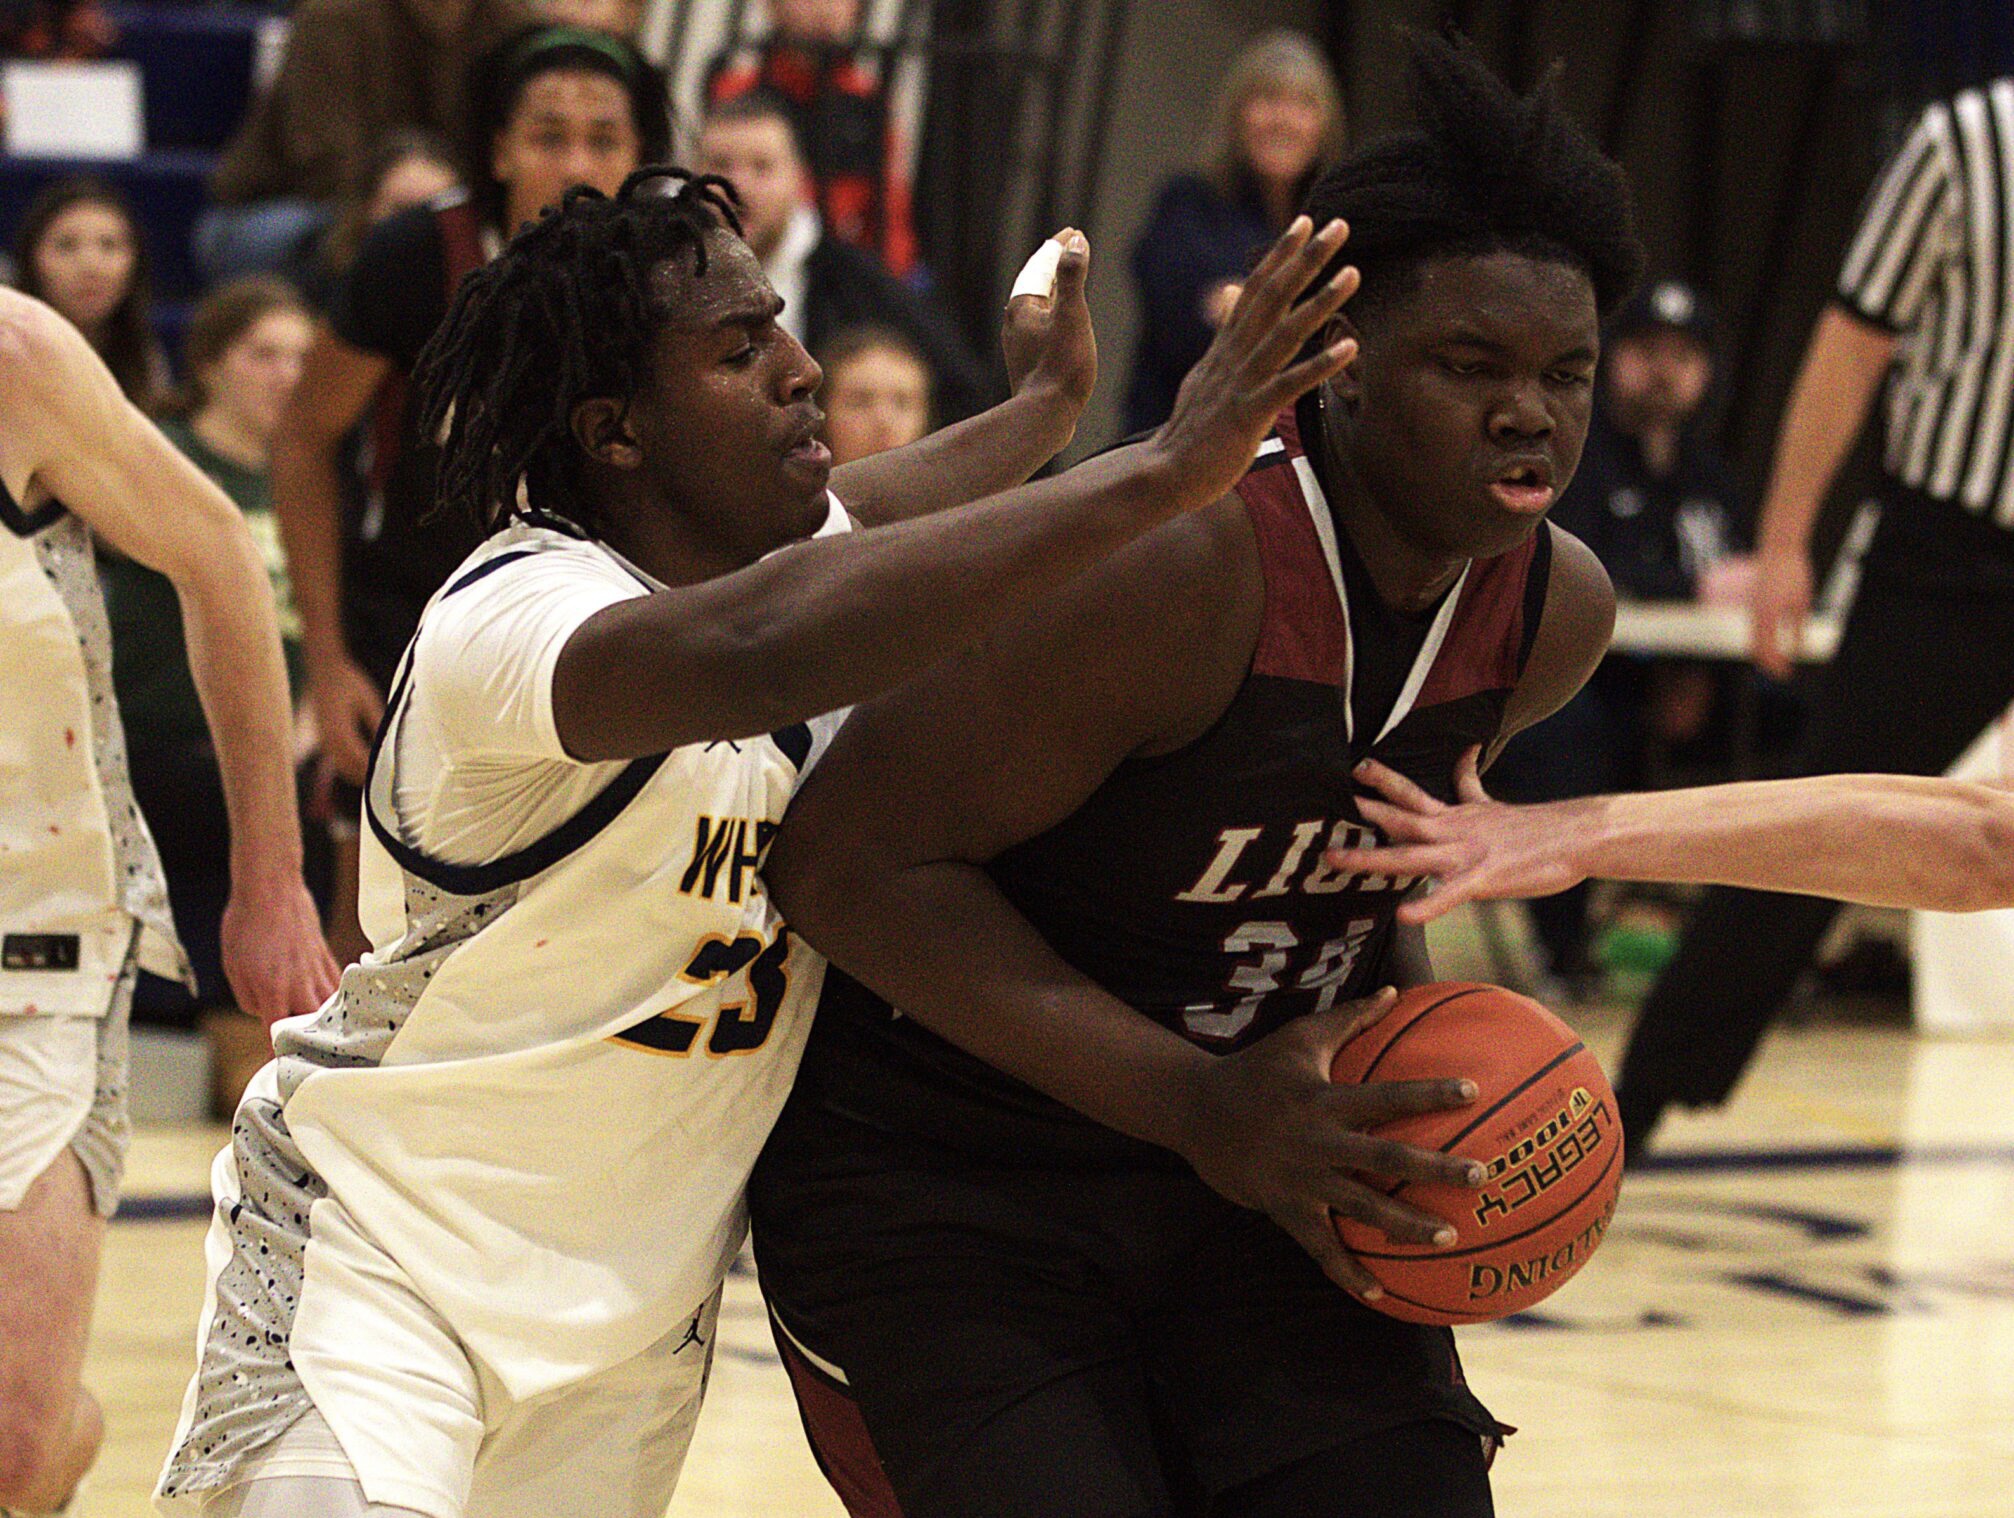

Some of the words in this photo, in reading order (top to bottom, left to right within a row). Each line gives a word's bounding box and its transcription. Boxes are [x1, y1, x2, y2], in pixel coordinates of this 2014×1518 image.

[603, 920, 792, 1059] 23
[1183, 917, 1375, 1039] 34
[1473, 1096, 1613, 1228] LEGACY
[1486, 1107, 1573, 1181] 1000
